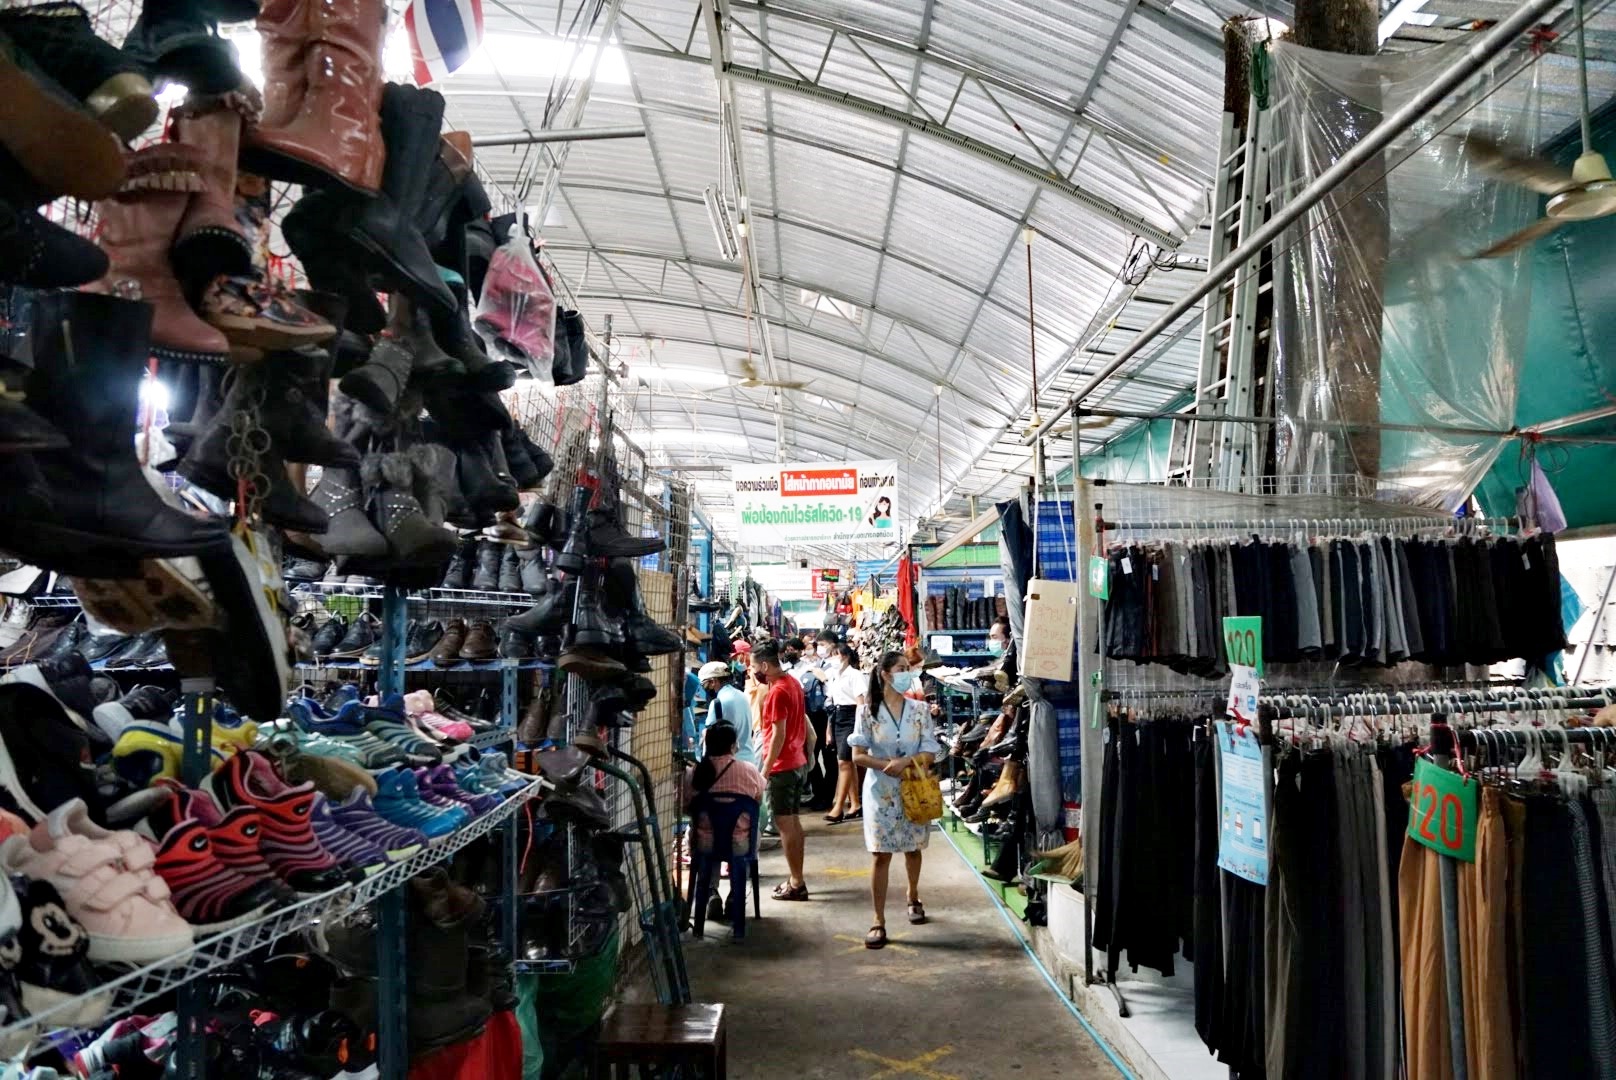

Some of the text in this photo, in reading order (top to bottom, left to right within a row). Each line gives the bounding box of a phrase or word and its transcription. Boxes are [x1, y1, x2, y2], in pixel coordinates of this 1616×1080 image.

[782, 472, 856, 492] ใส่หน้ากากอนามัย
[741, 502, 863, 525] เพื่อป้องกันไวรัสโควิด-19
[1228, 629, 1256, 668] 120
[1411, 780, 1464, 851] 120
